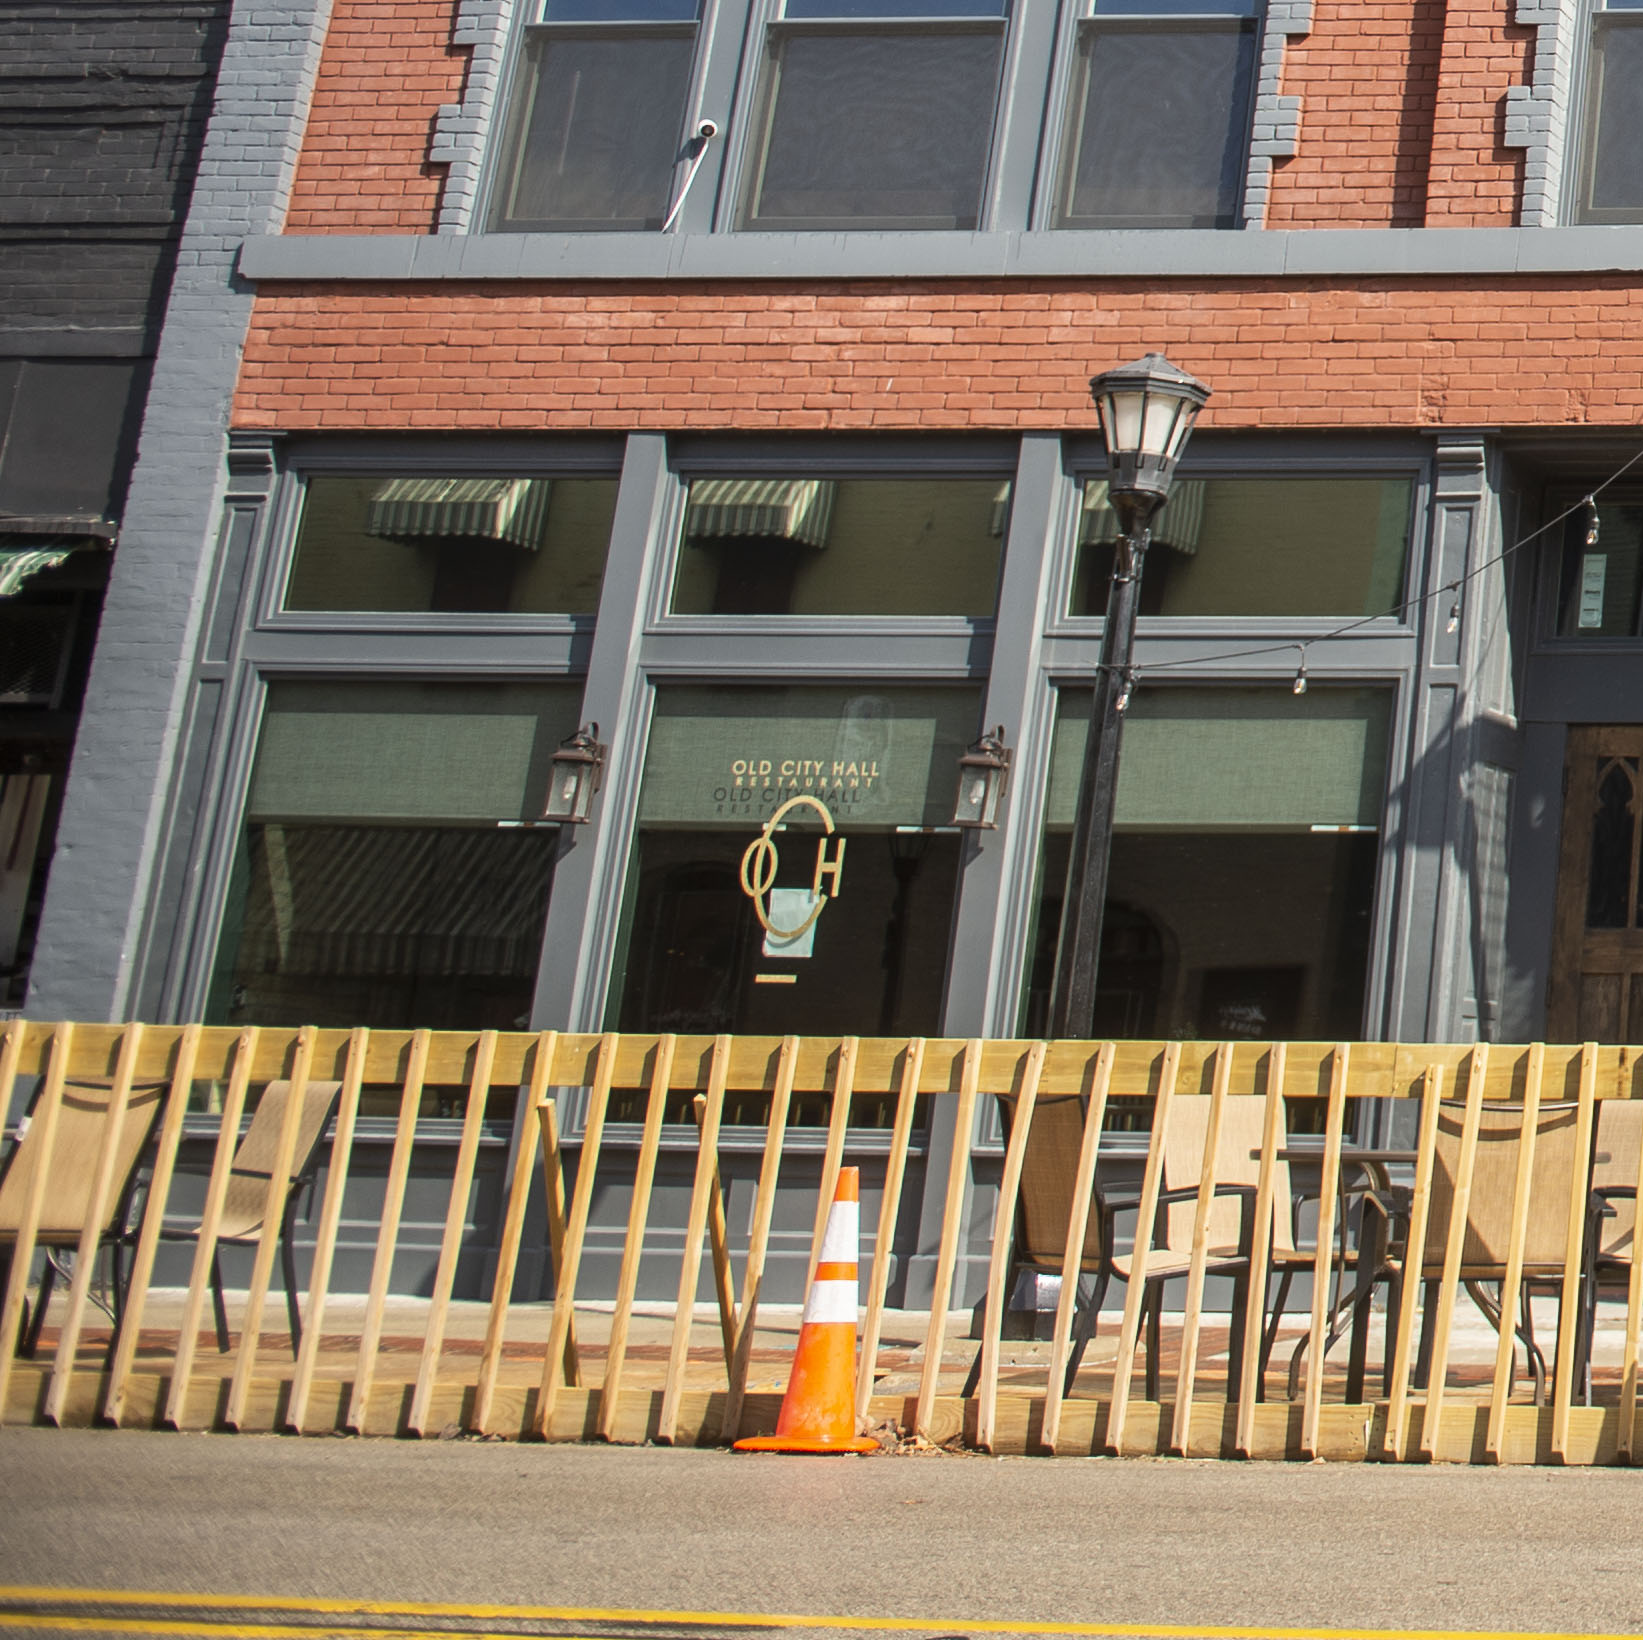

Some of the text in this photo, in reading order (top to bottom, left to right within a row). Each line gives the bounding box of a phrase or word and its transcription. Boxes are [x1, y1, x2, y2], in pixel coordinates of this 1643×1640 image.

[732, 759, 880, 777] OLD CITY HALL
[735, 776, 873, 788] RESTAURANT
